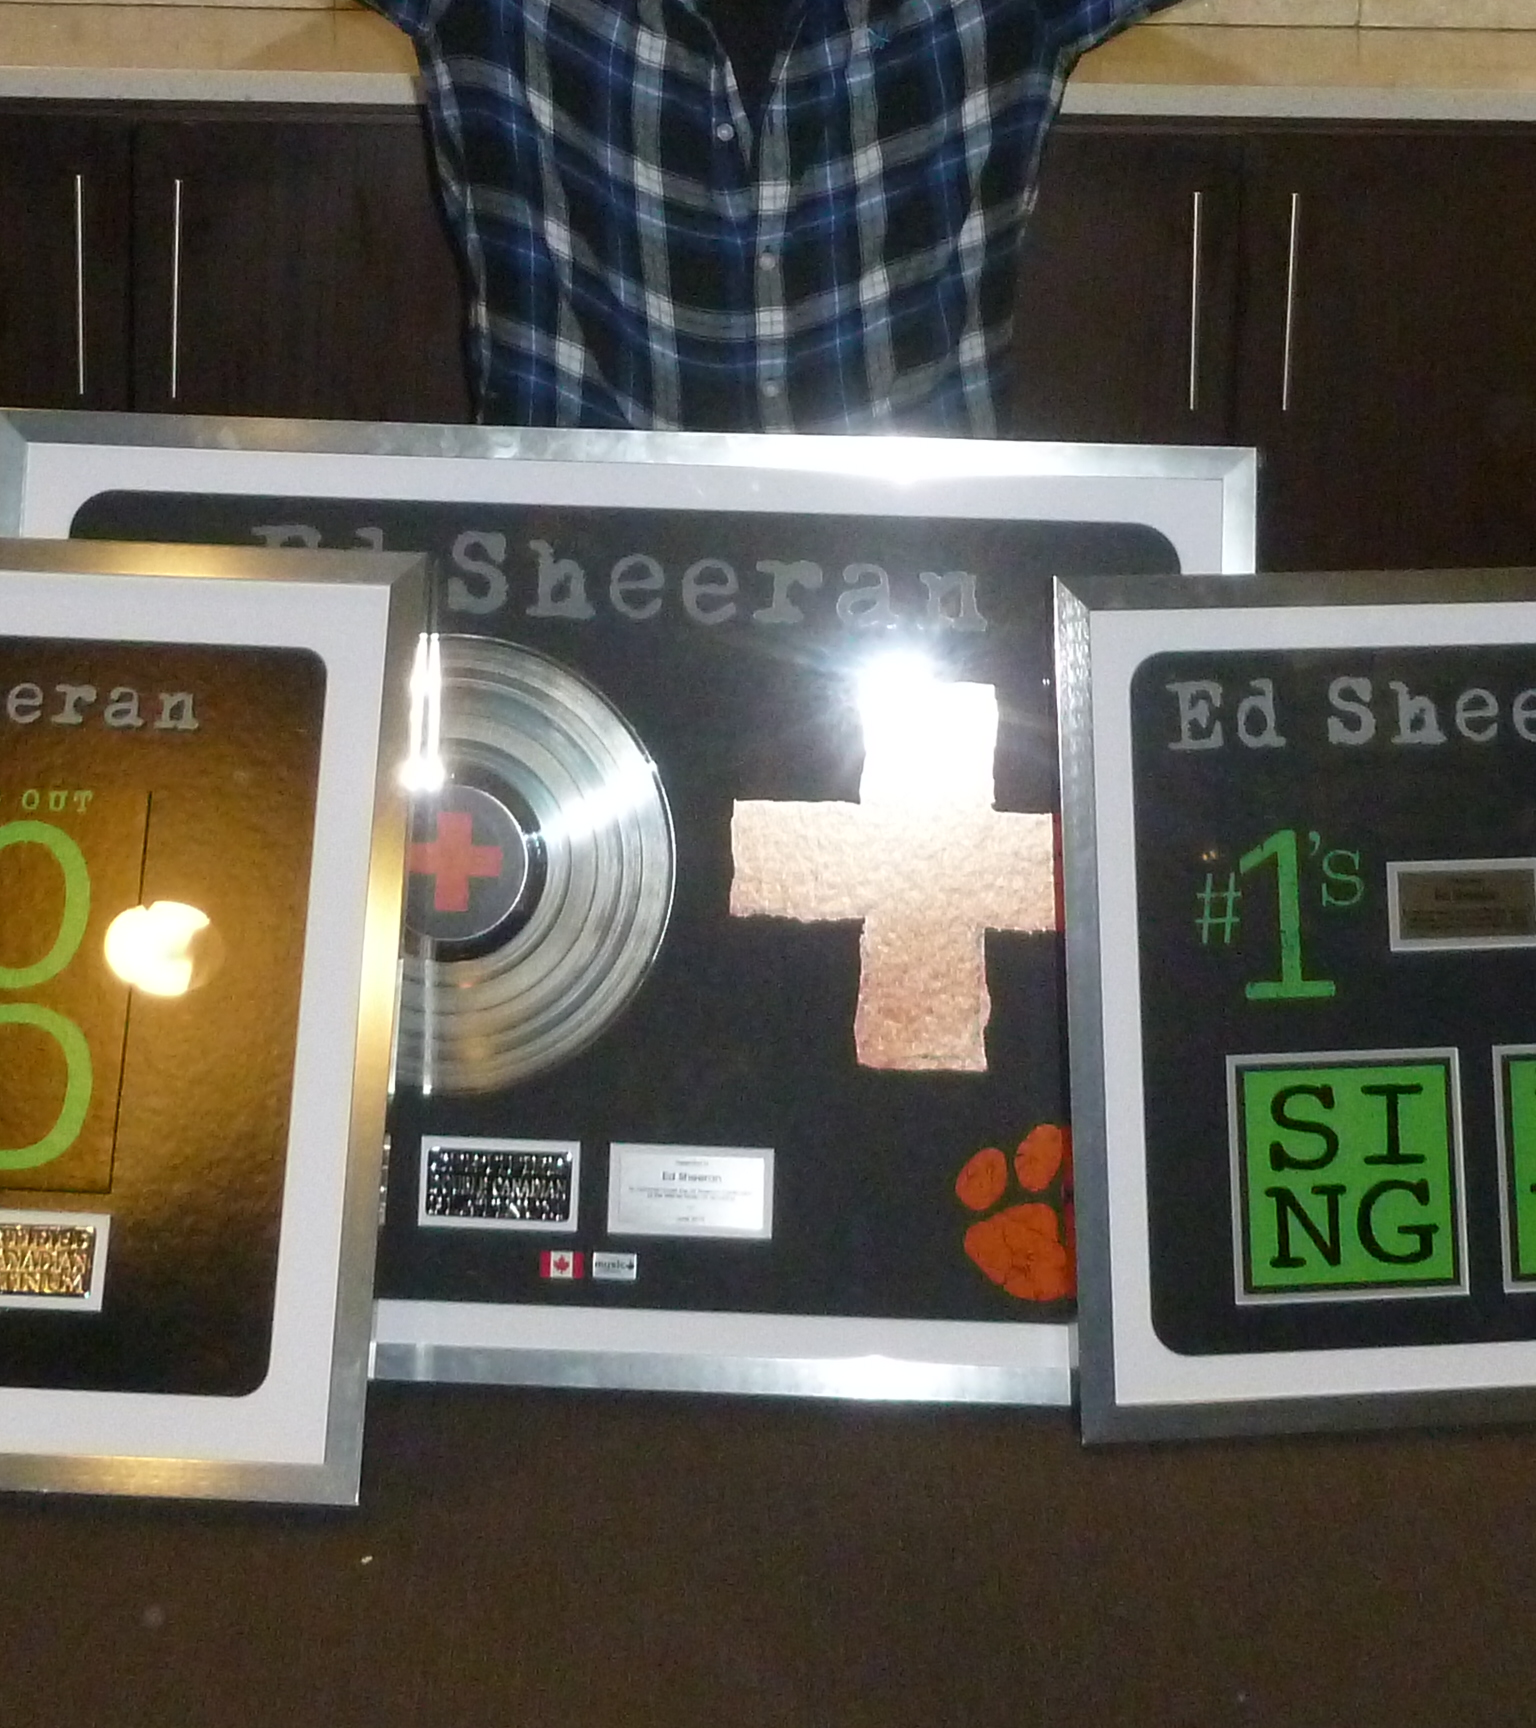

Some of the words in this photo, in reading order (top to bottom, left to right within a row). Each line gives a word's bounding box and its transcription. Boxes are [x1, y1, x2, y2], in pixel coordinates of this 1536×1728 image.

[446, 529, 988, 632] Sheeran
[1165, 680, 1287, 752] Ed
[20, 787, 95, 814] OUT
